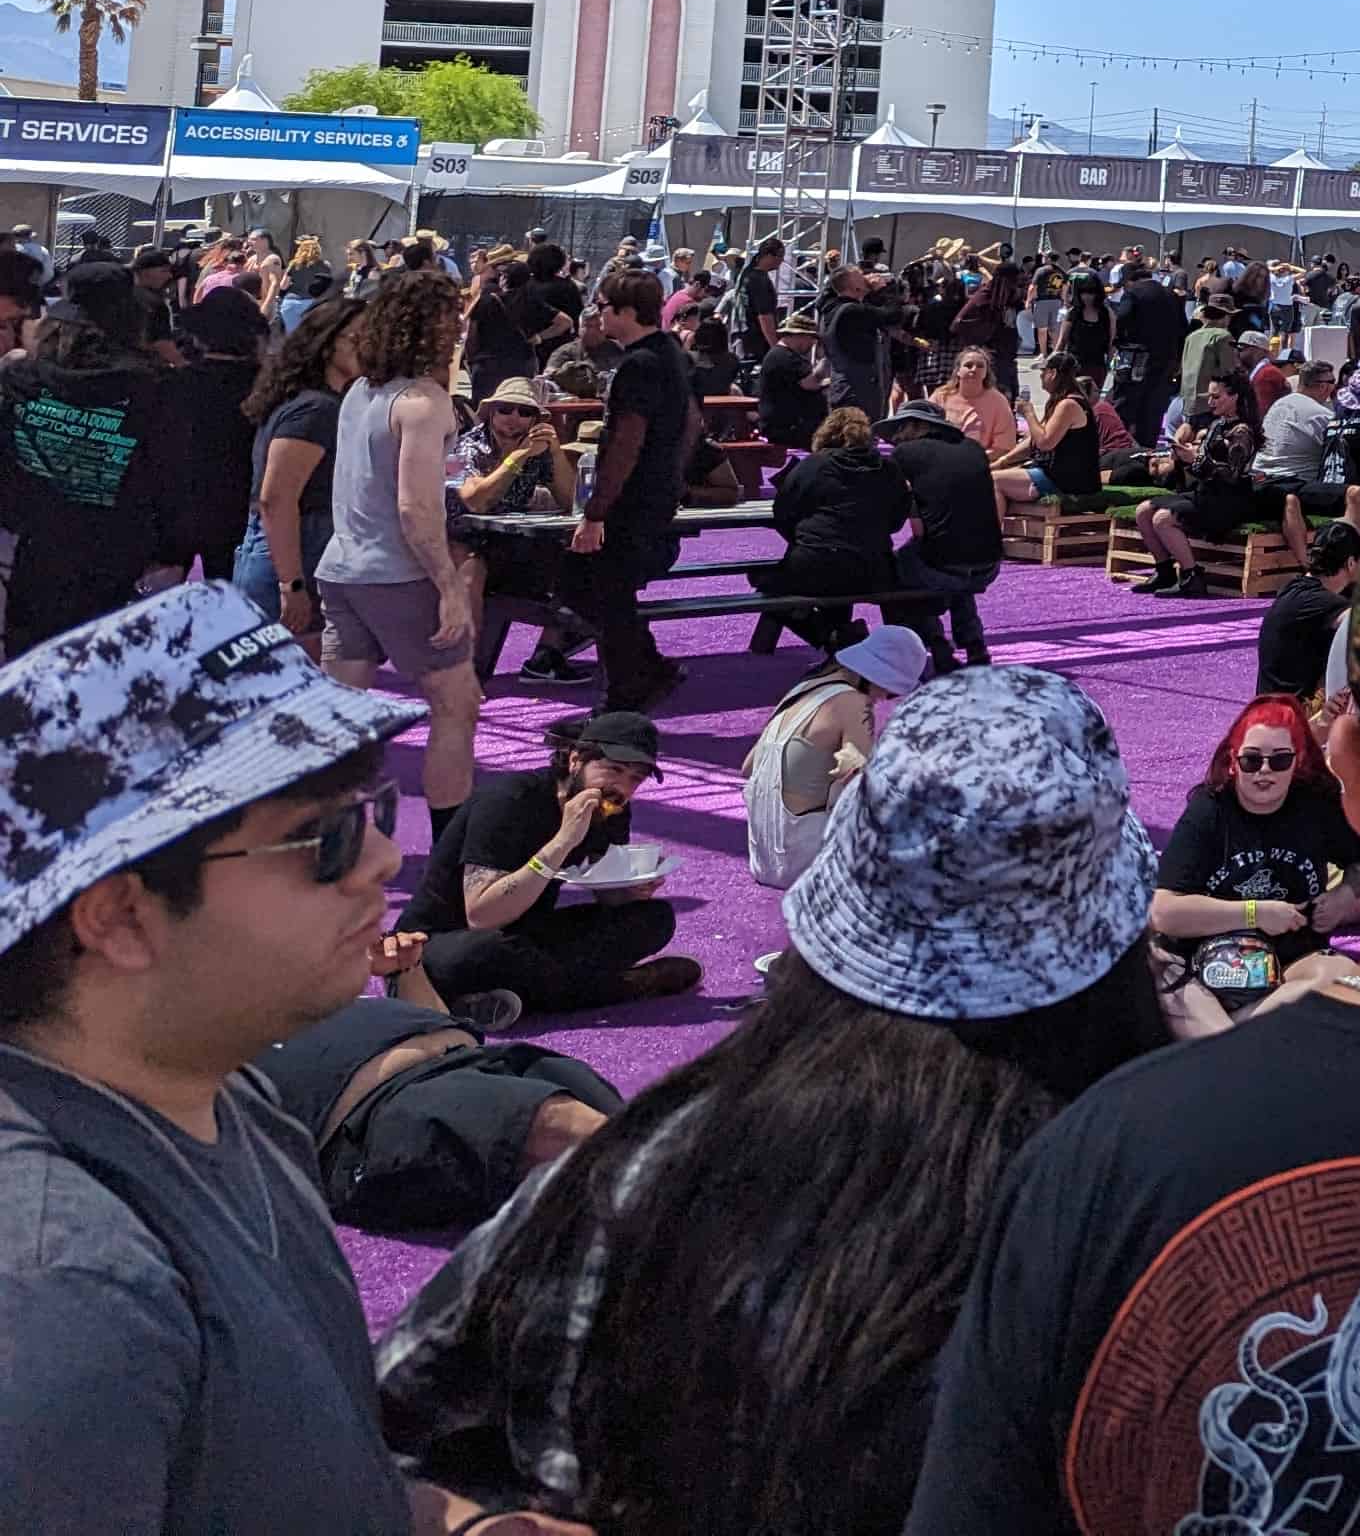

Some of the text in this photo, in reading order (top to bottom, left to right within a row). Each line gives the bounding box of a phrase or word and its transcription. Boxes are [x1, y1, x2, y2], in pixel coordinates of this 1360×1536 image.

[21, 120, 149, 145] SERVICES
[185, 124, 393, 148] ACCESSIBILITY SERVICES
[431, 157, 467, 174] S03
[629, 169, 660, 185] S03
[1079, 168, 1108, 186] BAR
[217, 636, 260, 668] LAS
[1231, 850, 1265, 868] TIP
[1269, 847, 1297, 863] WE
